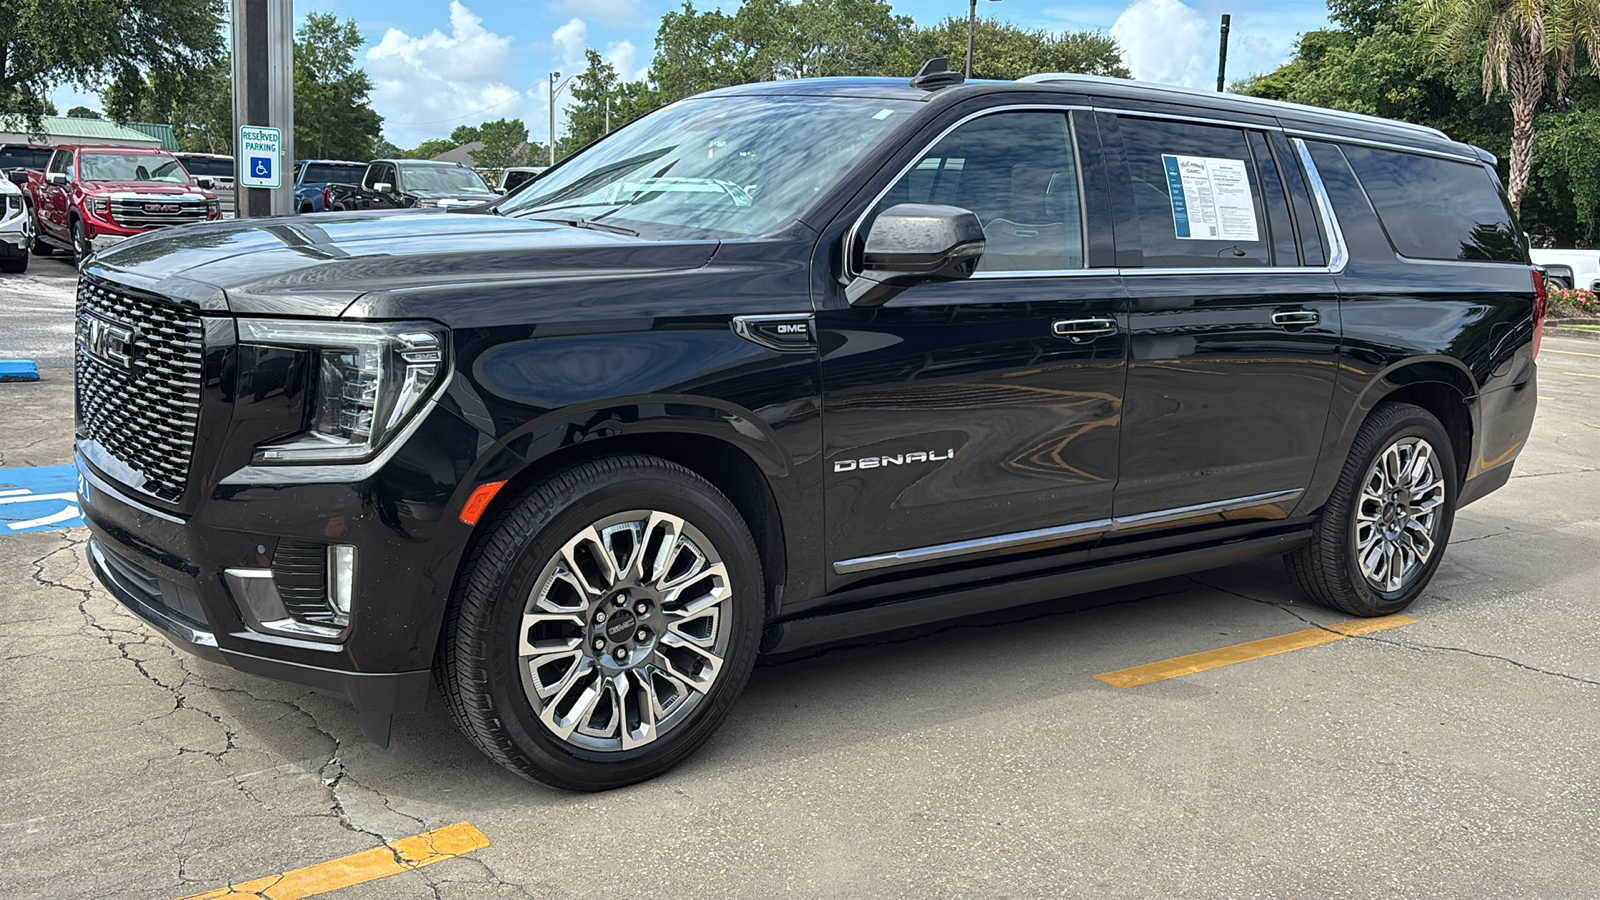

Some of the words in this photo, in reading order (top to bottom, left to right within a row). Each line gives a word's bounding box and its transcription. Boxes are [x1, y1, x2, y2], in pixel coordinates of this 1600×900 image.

[243, 131, 279, 142] RESERVED
[245, 142, 276, 152] PARKING
[144, 204, 180, 212] GMC
[777, 324, 807, 333] GMC
[79, 313, 131, 368] GMC
[833, 448, 954, 473] DENALI
[608, 617, 635, 636] GMC
